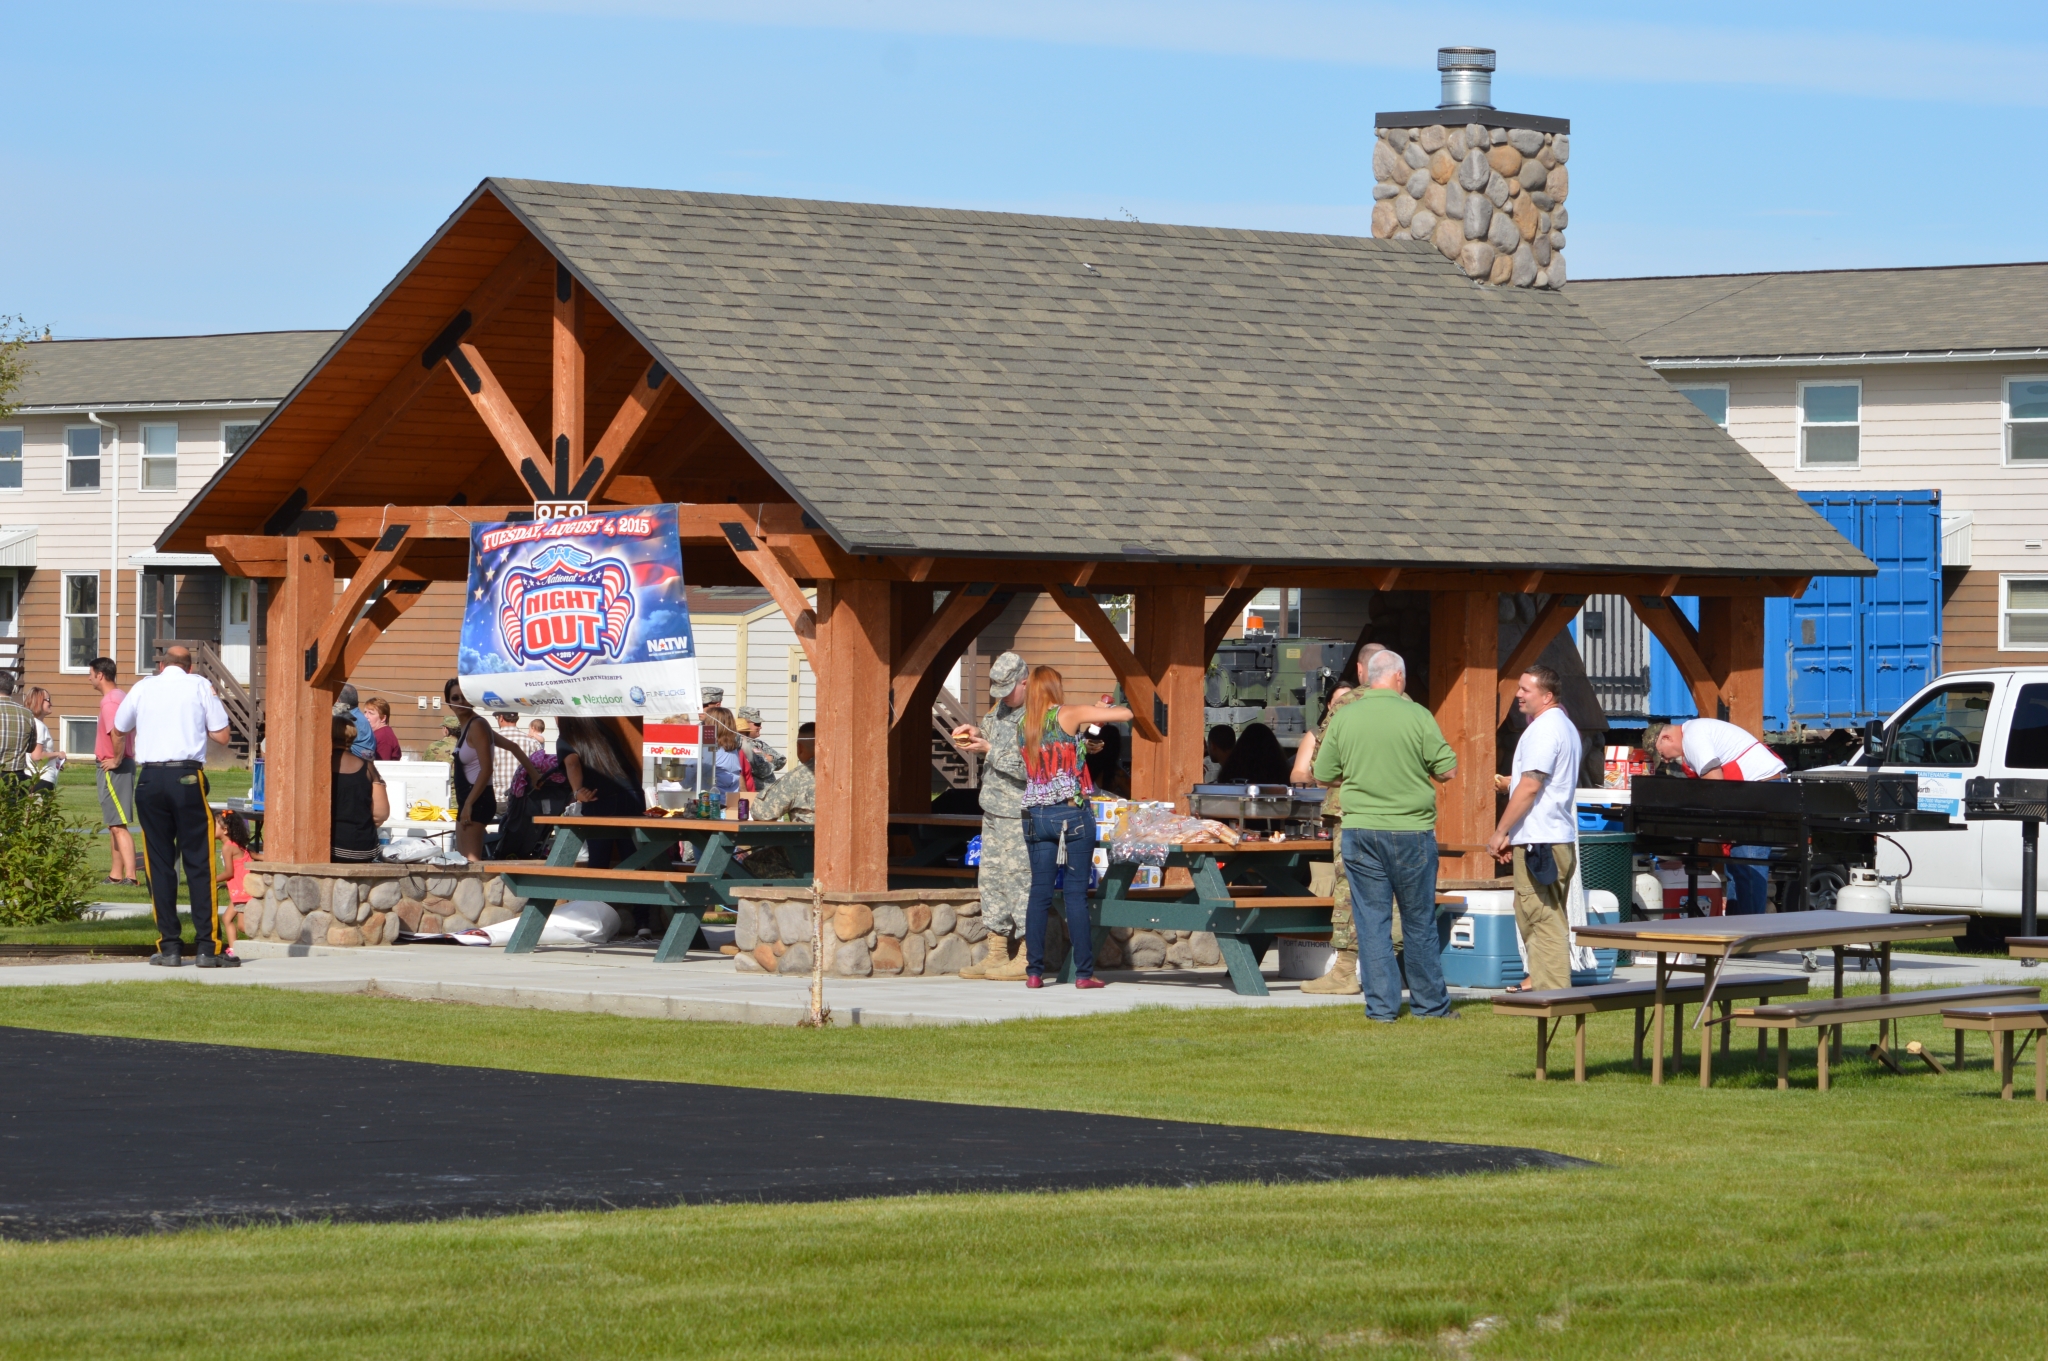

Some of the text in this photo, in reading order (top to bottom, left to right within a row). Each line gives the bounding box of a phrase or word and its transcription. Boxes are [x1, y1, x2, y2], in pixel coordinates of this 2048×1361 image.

[483, 517, 650, 550] TUESDAY, AUGUST 4, 2015
[542, 573, 579, 585] National
[526, 590, 599, 616] NIGHT
[526, 615, 600, 650] OUT
[646, 636, 687, 652] NATW
[582, 693, 623, 705] Nextdoor
[651, 746, 691, 756] POP CORN
